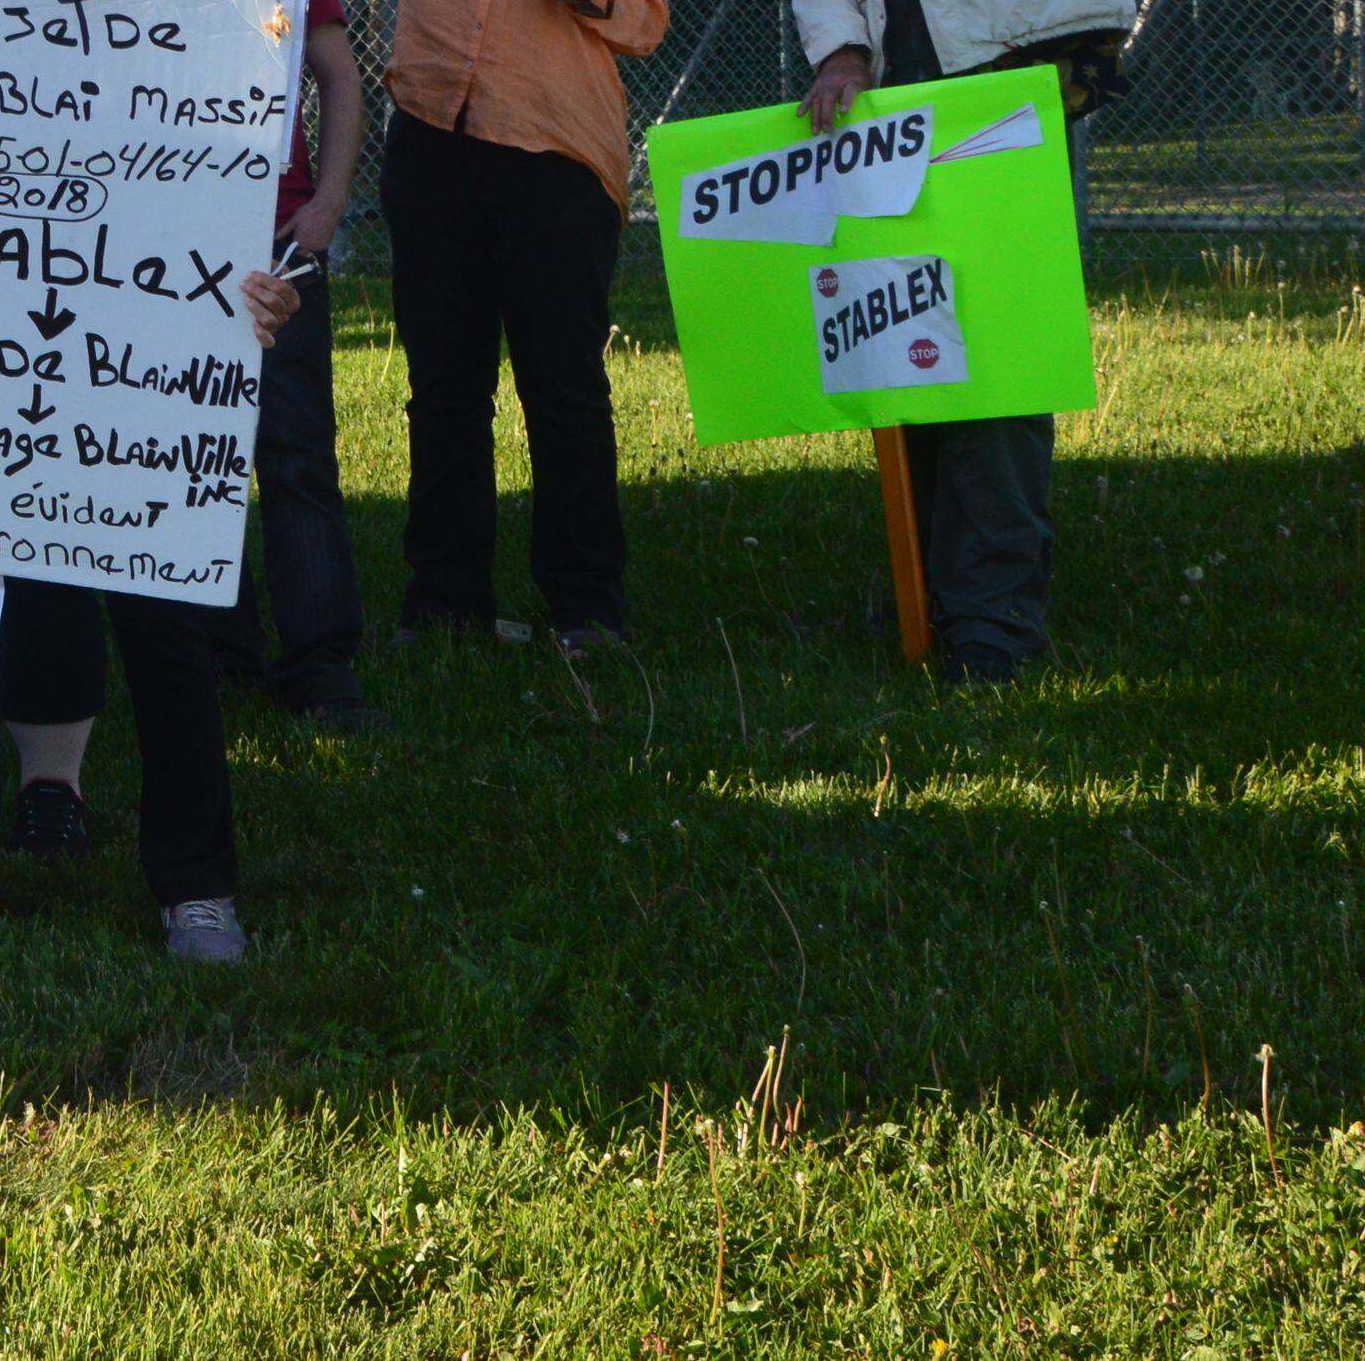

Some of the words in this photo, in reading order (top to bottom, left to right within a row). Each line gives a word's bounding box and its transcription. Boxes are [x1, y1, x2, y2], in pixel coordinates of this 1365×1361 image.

[693, 114, 925, 225] STOPPONS
[818, 277, 839, 289] STOP
[822, 258, 948, 364] STABLEX
[909, 348, 939, 361] STOP
